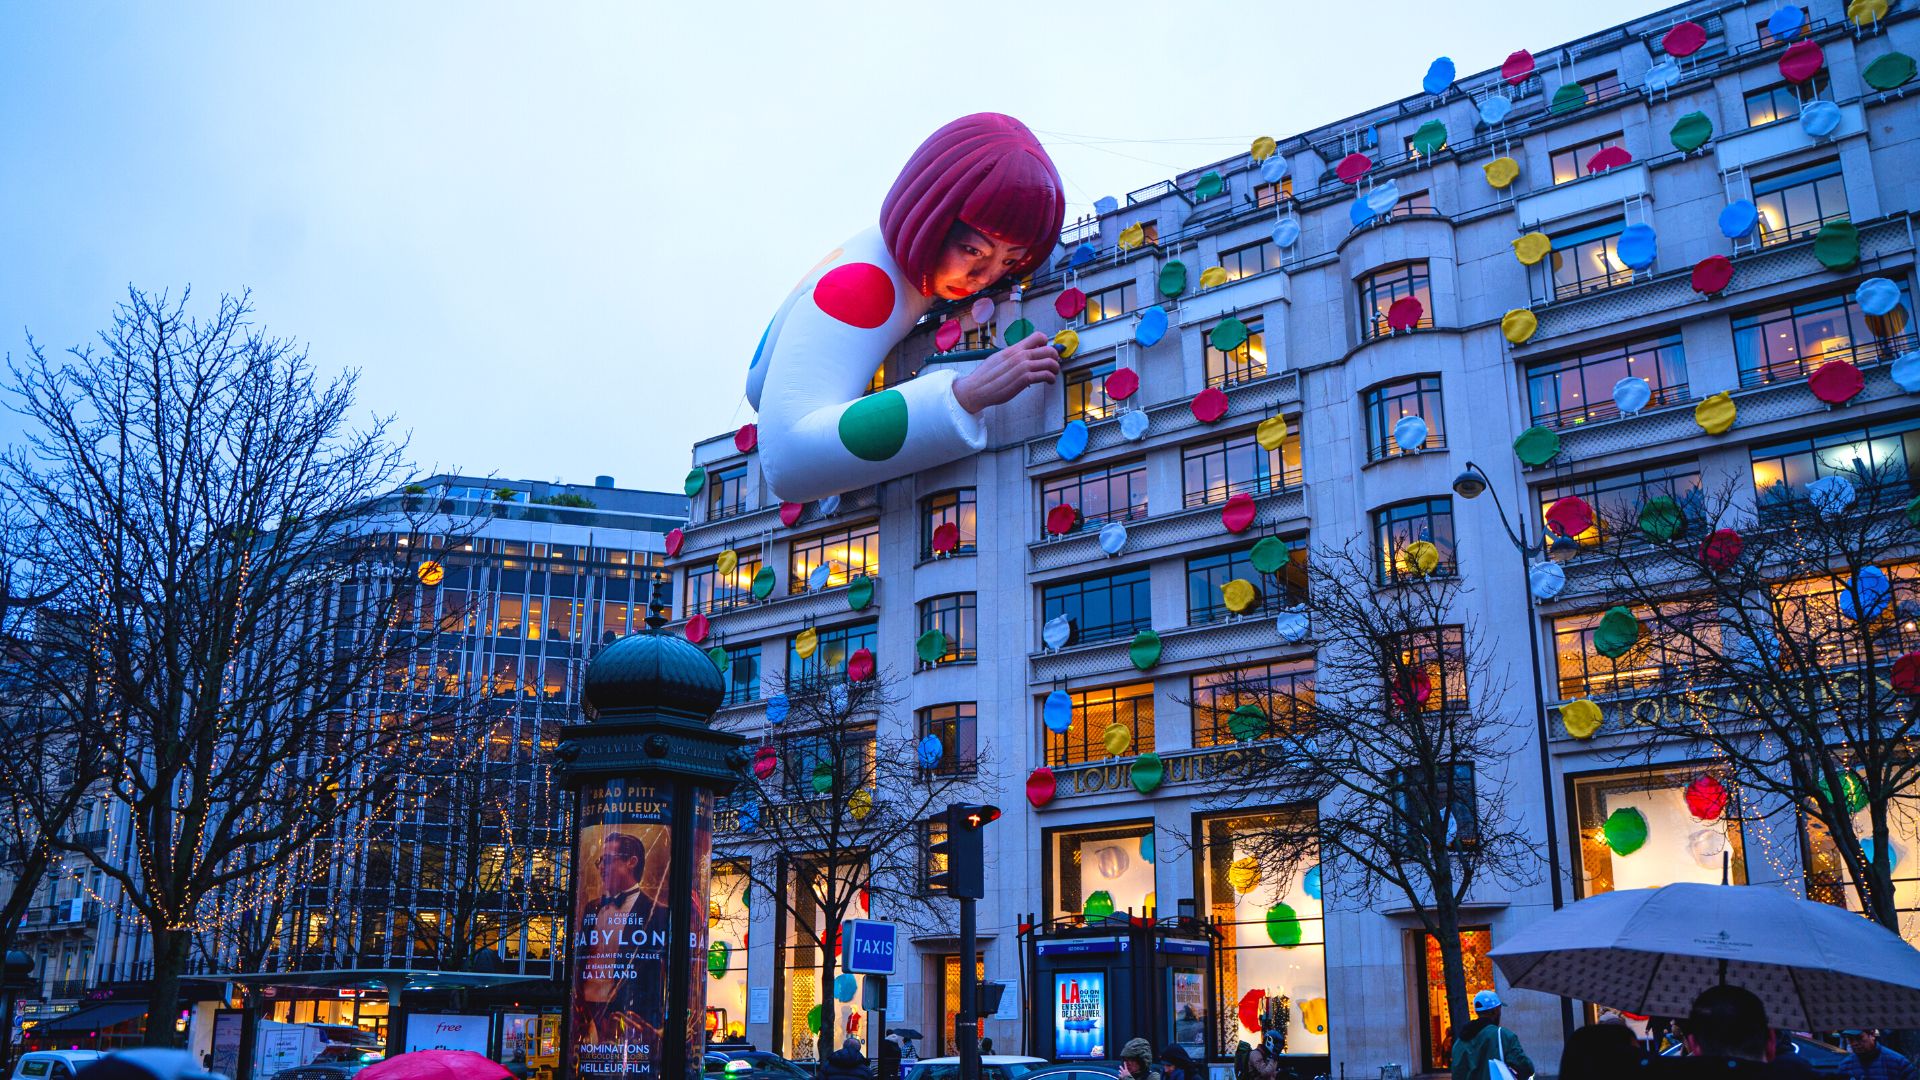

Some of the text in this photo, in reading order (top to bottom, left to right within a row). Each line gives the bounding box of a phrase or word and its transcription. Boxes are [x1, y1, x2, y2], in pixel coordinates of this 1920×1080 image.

[581, 742, 643, 755] SPECTACLES
[671, 744, 726, 761] SPECTACLES
[1074, 748, 1267, 793] LOUI UITTON
[627, 786, 655, 797] PITT
[581, 805, 595, 817] EST
[583, 917, 644, 926] PITT ROBBIE
[574, 930, 666, 947] BABYLON
[855, 937, 893, 957] TAXIS
[1038, 946, 1044, 956] P
[1121, 942, 1128, 952] P
[582, 970, 637, 979] LA LA LAND
[1062, 979, 1080, 1004] LÀ
[1061, 1003, 1100, 1011] EN ESSAYANT
[1061, 1010, 1069, 1018] DE
[435, 1021, 463, 1035] free
[580, 1044, 650, 1054] NOMINATONS
[580, 1062, 650, 1073] MEILLEUR FILM
